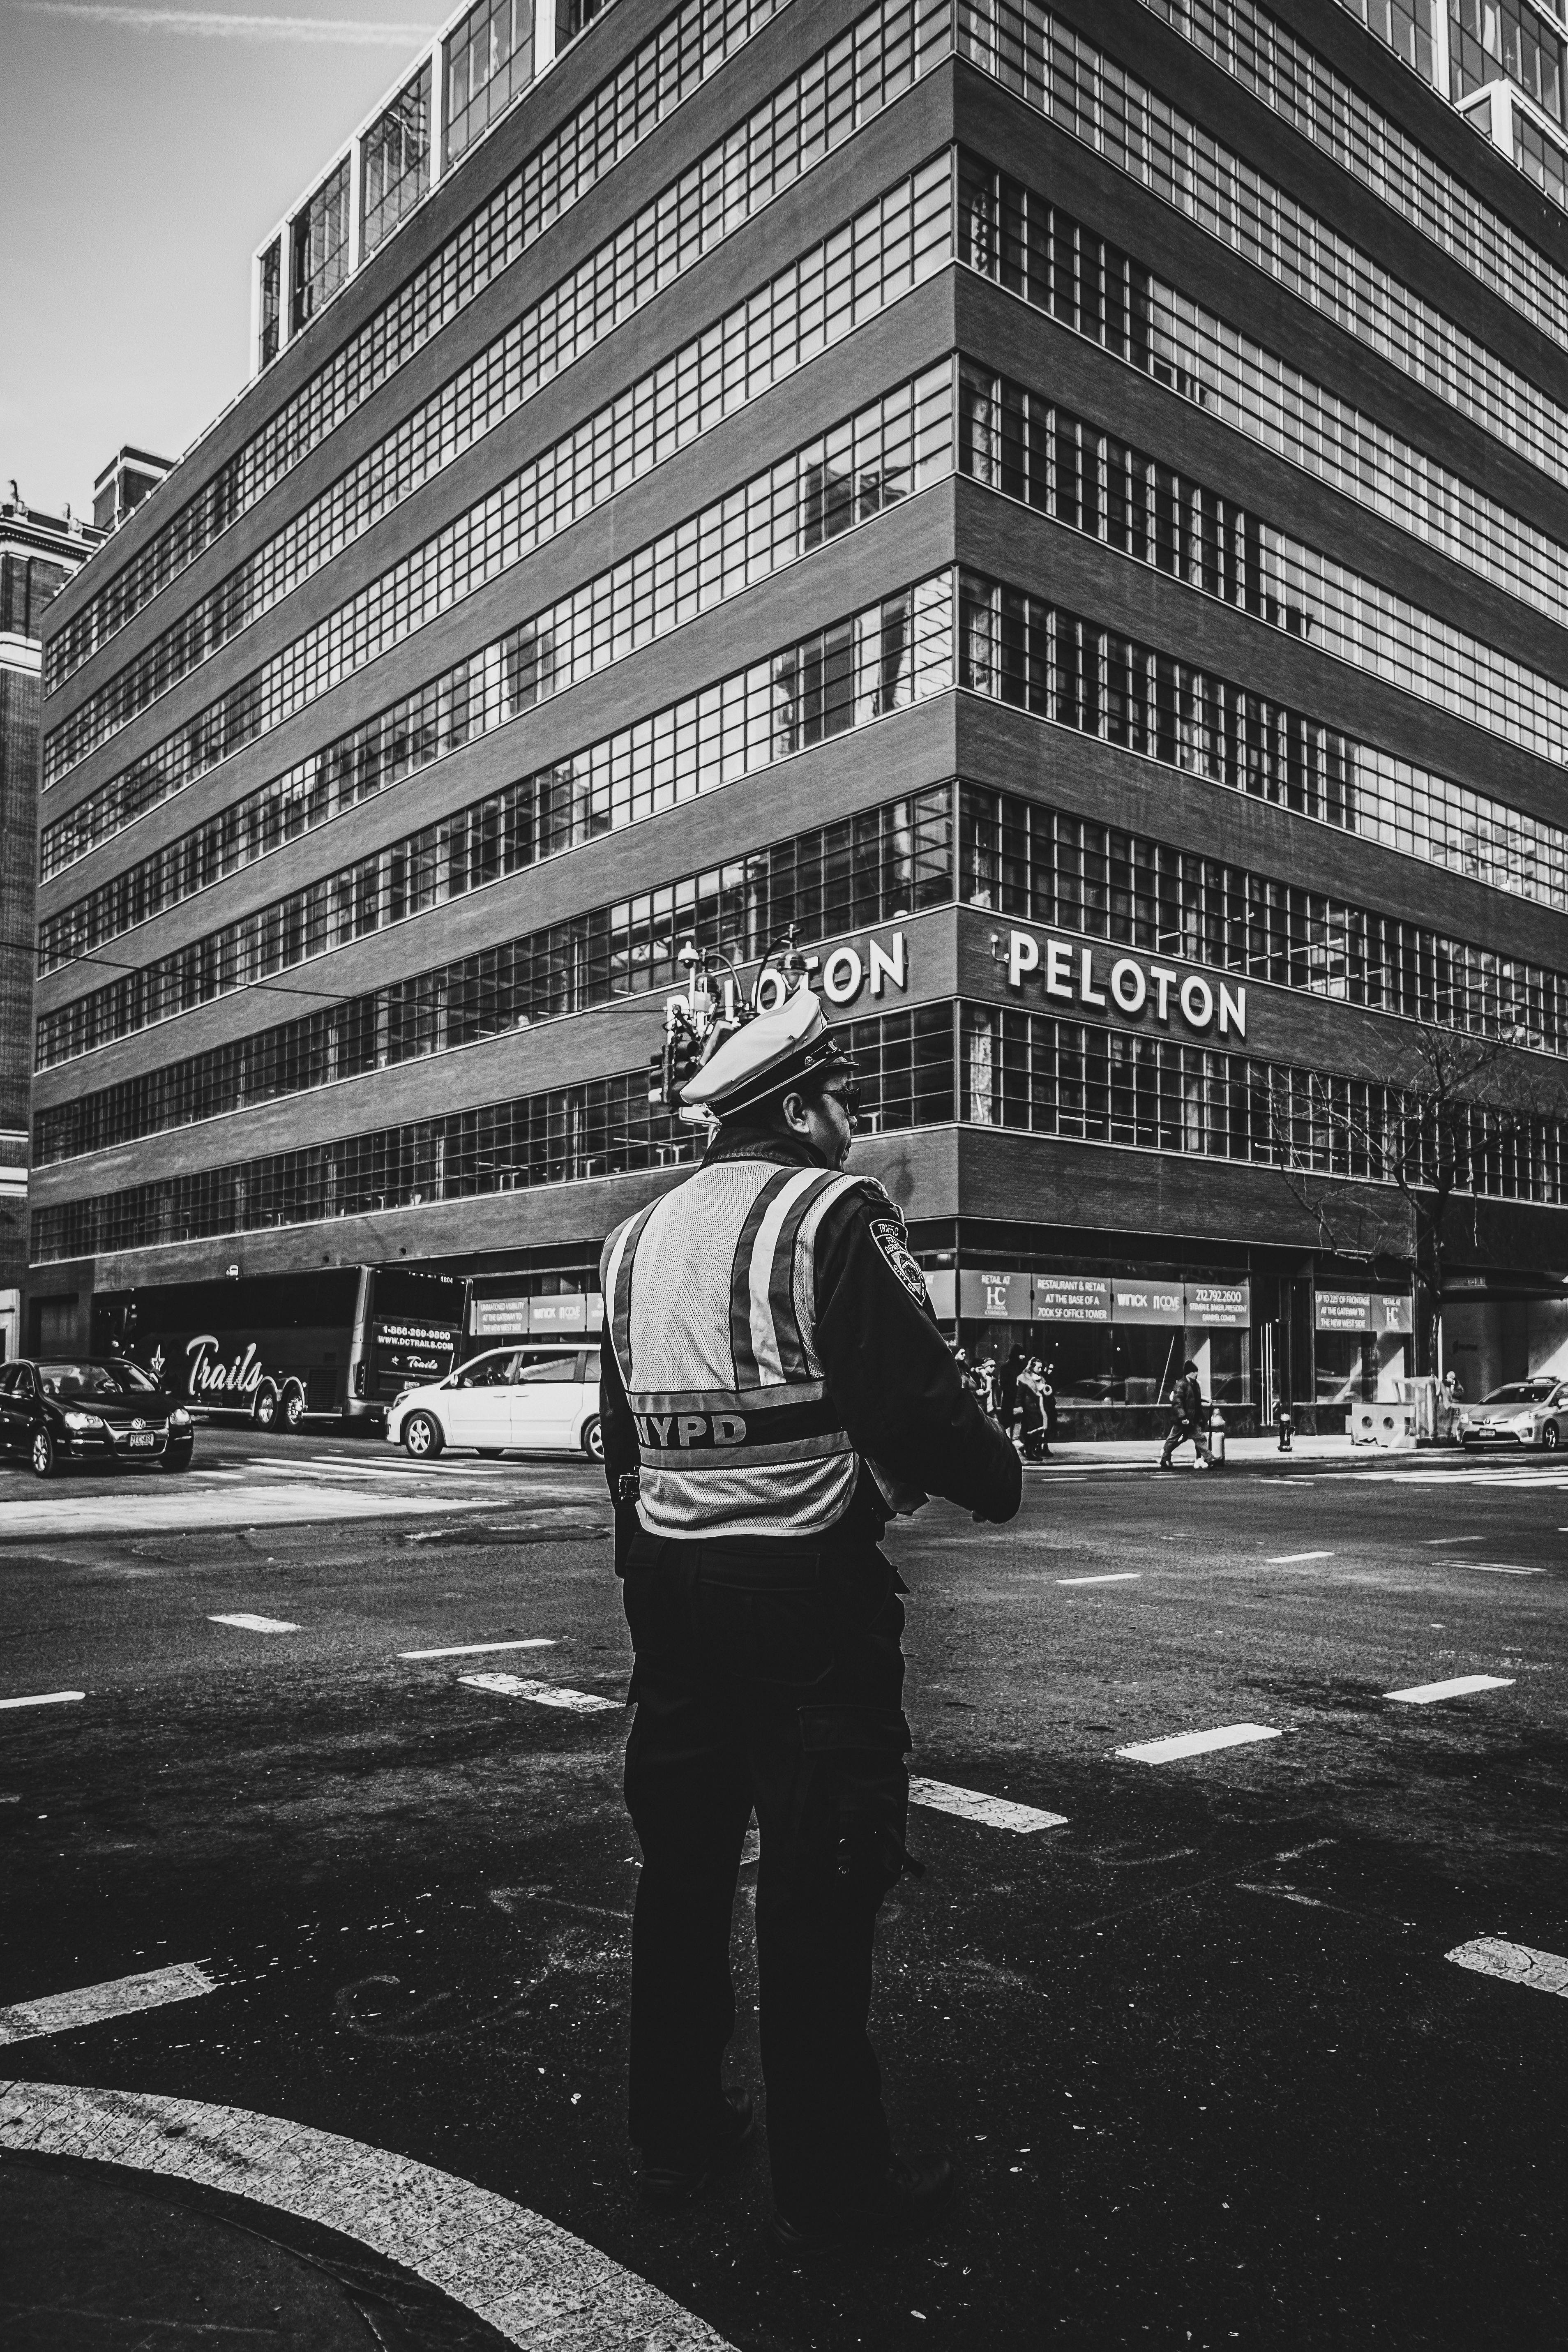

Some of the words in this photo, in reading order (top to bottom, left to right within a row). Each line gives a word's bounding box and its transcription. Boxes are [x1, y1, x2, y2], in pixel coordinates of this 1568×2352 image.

[666, 932, 903, 1045] PLOON
[1010, 929, 1246, 1038] PELOTON
[877, 1223, 899, 1236] TRAFFIC
[893, 1264, 907, 1281] CITY
[981, 1275, 1002, 1284] RETAIL
[1003, 1276, 1011, 1285] AT
[1038, 1279, 1078, 1290] RESTAURANT
[1079, 1281, 1084, 1291] &
[1085, 1282, 1107, 1292] RETAIL
[908, 1283, 916, 1292] OF
[987, 1287, 1006, 1305] HC
[1045, 1294, 1054, 1303] AT
[1054, 1294, 1068, 1304] THE
[1068, 1295, 1084, 1305] BASE
[1084, 1296, 1093, 1305] OF
[1094, 1296, 1100, 1305] A
[1196, 1289, 1241, 1303] 212.792.2600
[1316, 1294, 1322, 1302] UP
[1322, 1295, 1330, 1303] TO
[1339, 1296, 1346, 1304] OF
[1346, 1296, 1370, 1306] FRONTAGE
[496, 1313, 516, 1321] GATEWAY
[516, 1312, 522, 1321] TO
[1038, 1307, 1055, 1317] 700K
[1055, 1308, 1063, 1318] SF
[1063, 1309, 1085, 1319] OFFICE
[1085, 1310, 1107, 1319] TOWER
[1321, 1306, 1327, 1315] AT
[1327, 1306, 1337, 1315] THE
[1337, 1307, 1358, 1316] GATEWAY
[1358, 1308, 1365, 1317] TO
[1321, 1318, 1330, 1327] THE
[1330, 1319, 1342, 1328] NEW
[1342, 1319, 1355, 1328] WEST
[1355, 1319, 1365, 1329] SIDE
[378, 1335, 454, 1351] WWW.DCTRAILS.COM
[186, 1334, 263, 1395] Trails
[407, 1356, 438, 1370] Trails
[633, 1415, 746, 1446] NYPD
